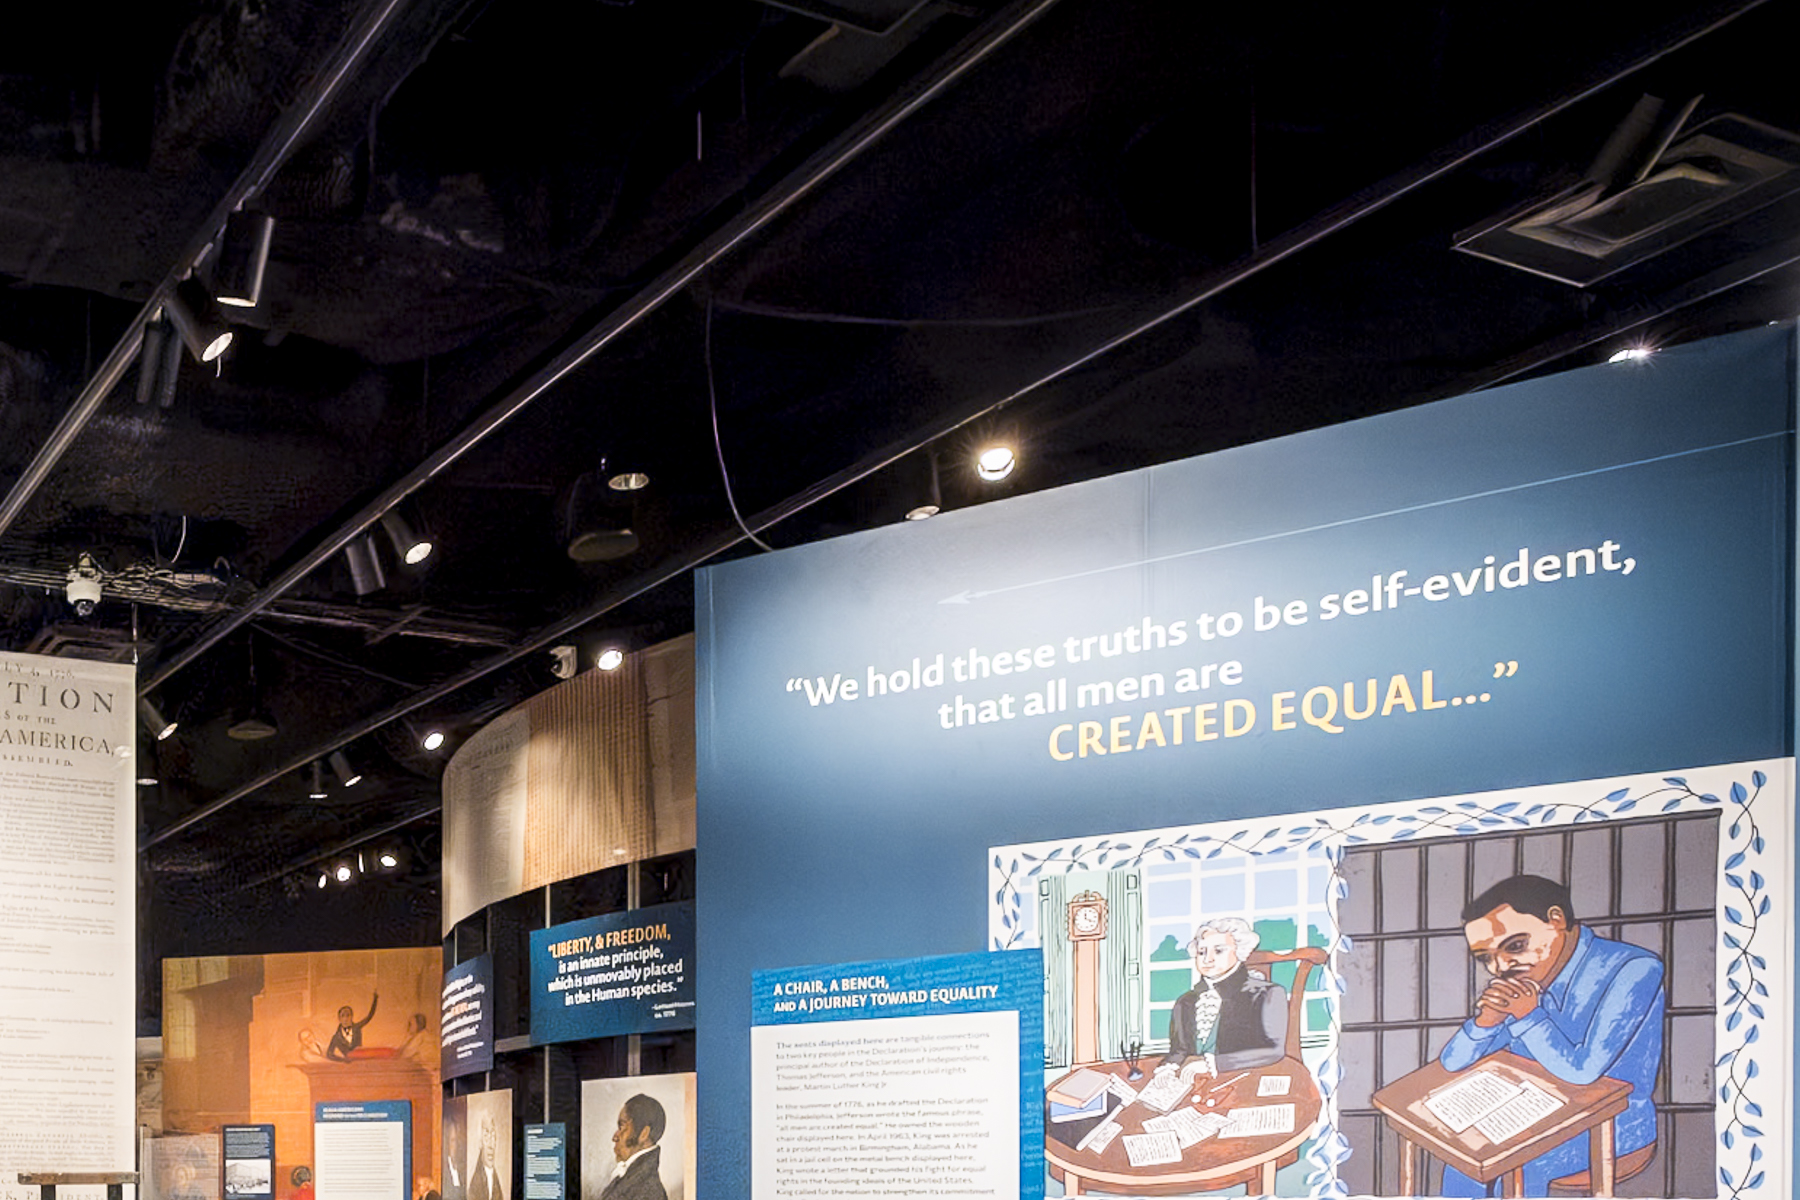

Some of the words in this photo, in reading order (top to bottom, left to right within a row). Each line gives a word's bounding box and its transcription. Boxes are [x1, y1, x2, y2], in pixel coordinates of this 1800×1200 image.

[786, 674, 859, 707] “We
[868, 654, 944, 697] hold
[952, 645, 1055, 682] these
[1064, 617, 1188, 662] truths
[1196, 612, 1243, 640] to
[1254, 596, 1311, 631] be
[1316, 540, 1636, 620] self-evident,
[939, 694, 1015, 729] that
[1024, 678, 1068, 717] all
[1078, 673, 1166, 708] men
[1173, 658, 1244, 695] are
[0, 729, 114, 757] AMERICA,
[1049, 699, 1256, 761] CREATED
[595, 933, 604, 950] &
[606, 923, 671, 948] FREEDOM,
[558, 960, 566, 974] is
[567, 961, 579, 972] an
[580, 955, 610, 970] innate
[611, 944, 664, 968] principle,
[548, 975, 573, 993] which
[574, 974, 582, 988] is
[583, 964, 642, 986] unmovably
[643, 958, 683, 977] placed
[773, 983, 783, 996] A
[785, 980, 828, 995] CHAIR,
[830, 979, 839, 992] A
[842, 976, 889, 991] BENCH,
[575, 989, 591, 1005] the
[592, 984, 630, 1002] Human
[774, 1001, 796, 1012] AND
[798, 999, 807, 1010] A
[808, 994, 867, 1013] JOURNEY
[870, 990, 928, 1006] TOWARD
[930, 985, 998, 1004] EQUALITY
